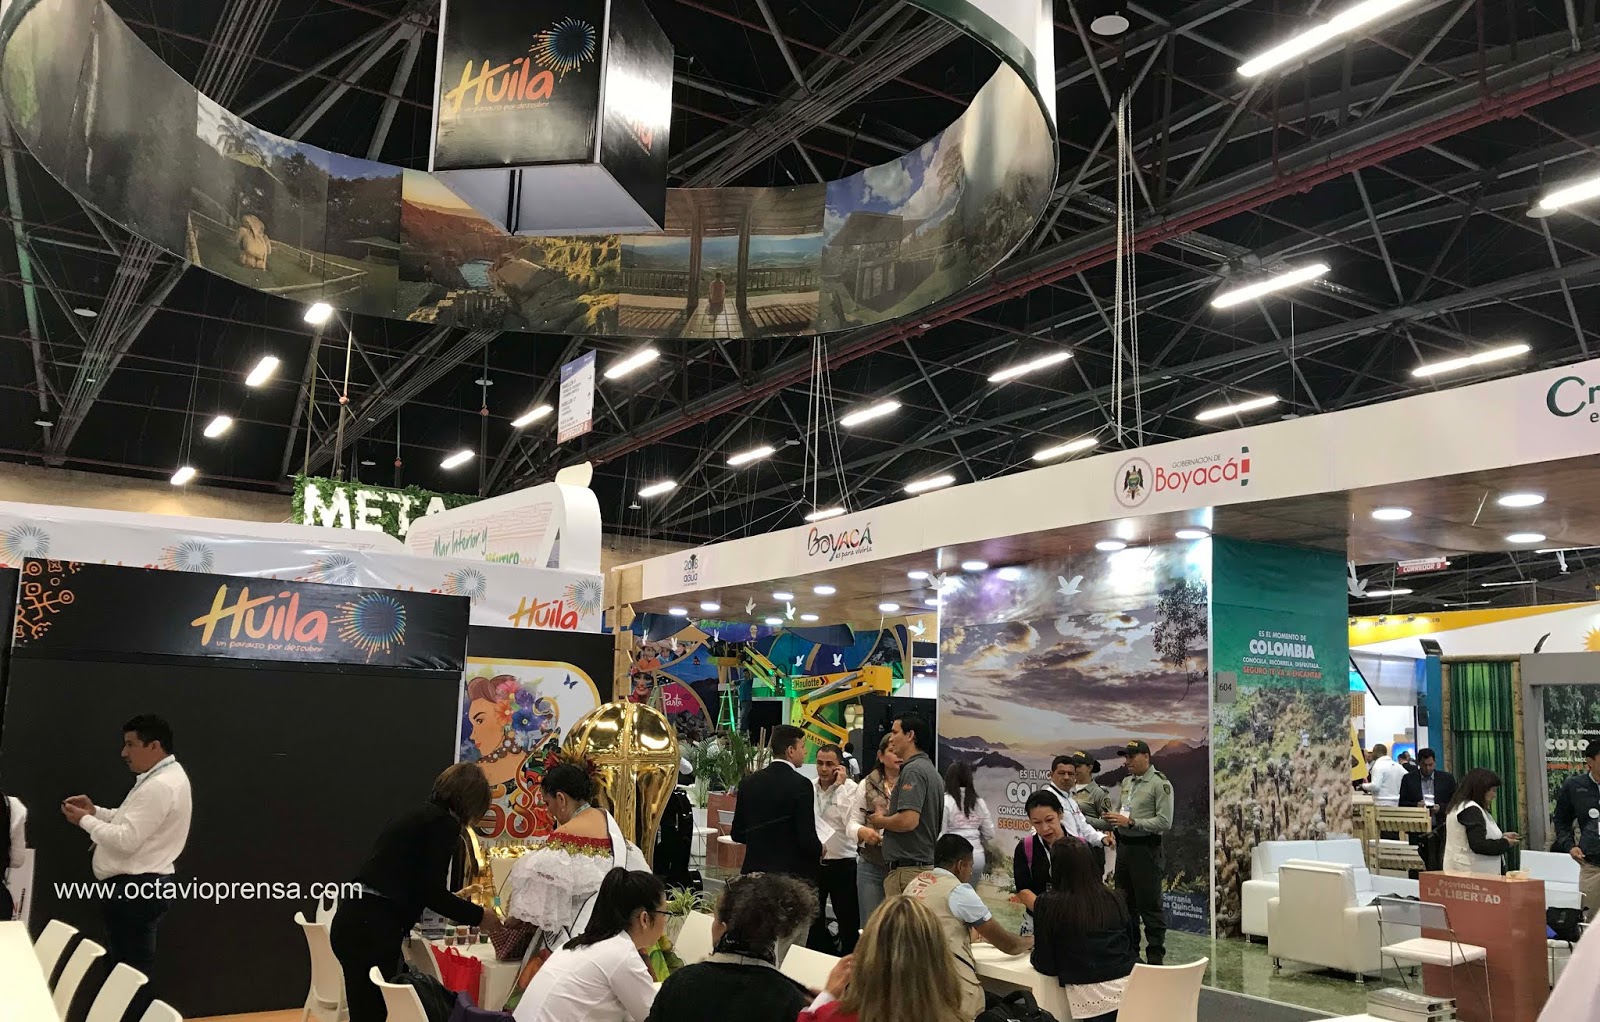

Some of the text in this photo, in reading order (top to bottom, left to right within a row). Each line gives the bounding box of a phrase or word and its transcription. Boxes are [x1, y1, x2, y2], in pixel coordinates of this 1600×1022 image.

[445, 56, 555, 113] Huila
[1172, 454, 1221, 469] GOBERNACIÓN DE
[1155, 457, 1238, 493] Boyacá
[432, 526, 488, 557] Mar Interior y
[841, 551, 855, 560] para
[1403, 563, 1435, 573] CORREDOR
[191, 583, 329, 646] Huila
[508, 596, 578, 631] Huila
[1258, 630, 1265, 638] ES
[1272, 632, 1300, 641] MOMENTO
[1300, 634, 1307, 642] DE
[216, 640, 227, 648] un
[267, 643, 282, 651] por
[1249, 639, 1315, 659] COLOMBIA
[1243, 665, 1268, 675] SEGURO
[1292, 670, 1322, 679] ENCANTAR
[795, 678, 820, 689] Haulotte
[1218, 683, 1232, 692] 604
[1544, 738, 1590, 752] COLO
[1019, 770, 1028, 779] ES
[1029, 770, 1037, 779] EL
[1006, 781, 1052, 804] CO
[998, 817, 1031, 831] SEGURO
[1439, 879, 1480, 891] Provincia
[1427, 887, 1501, 905] LA LIBERTAD
[1171, 902, 1203, 913] Quinchas
